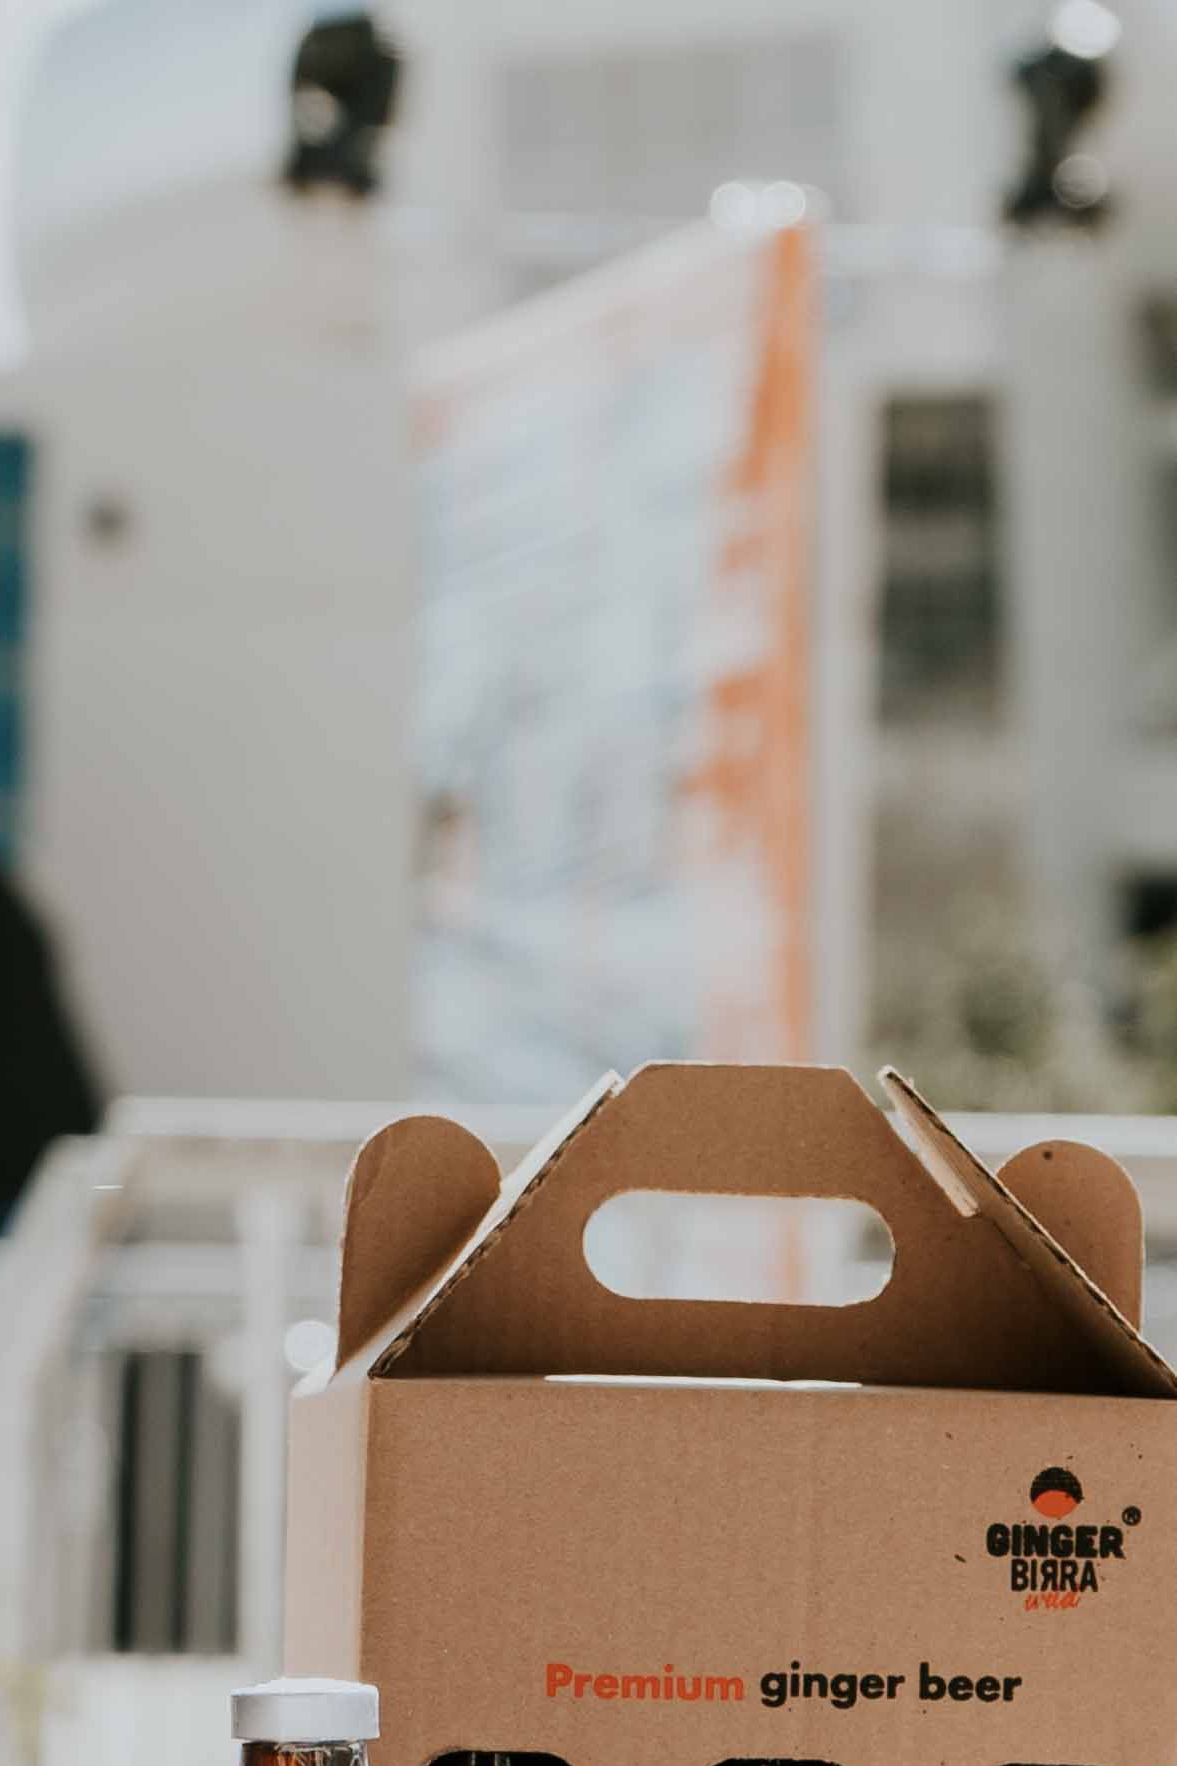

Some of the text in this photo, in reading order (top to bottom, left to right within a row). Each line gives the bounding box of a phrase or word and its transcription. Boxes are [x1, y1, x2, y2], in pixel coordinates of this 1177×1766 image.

[986, 1523, 1125, 1559] GINGER
[545, 1661, 1022, 1709] Premium ginger beer
